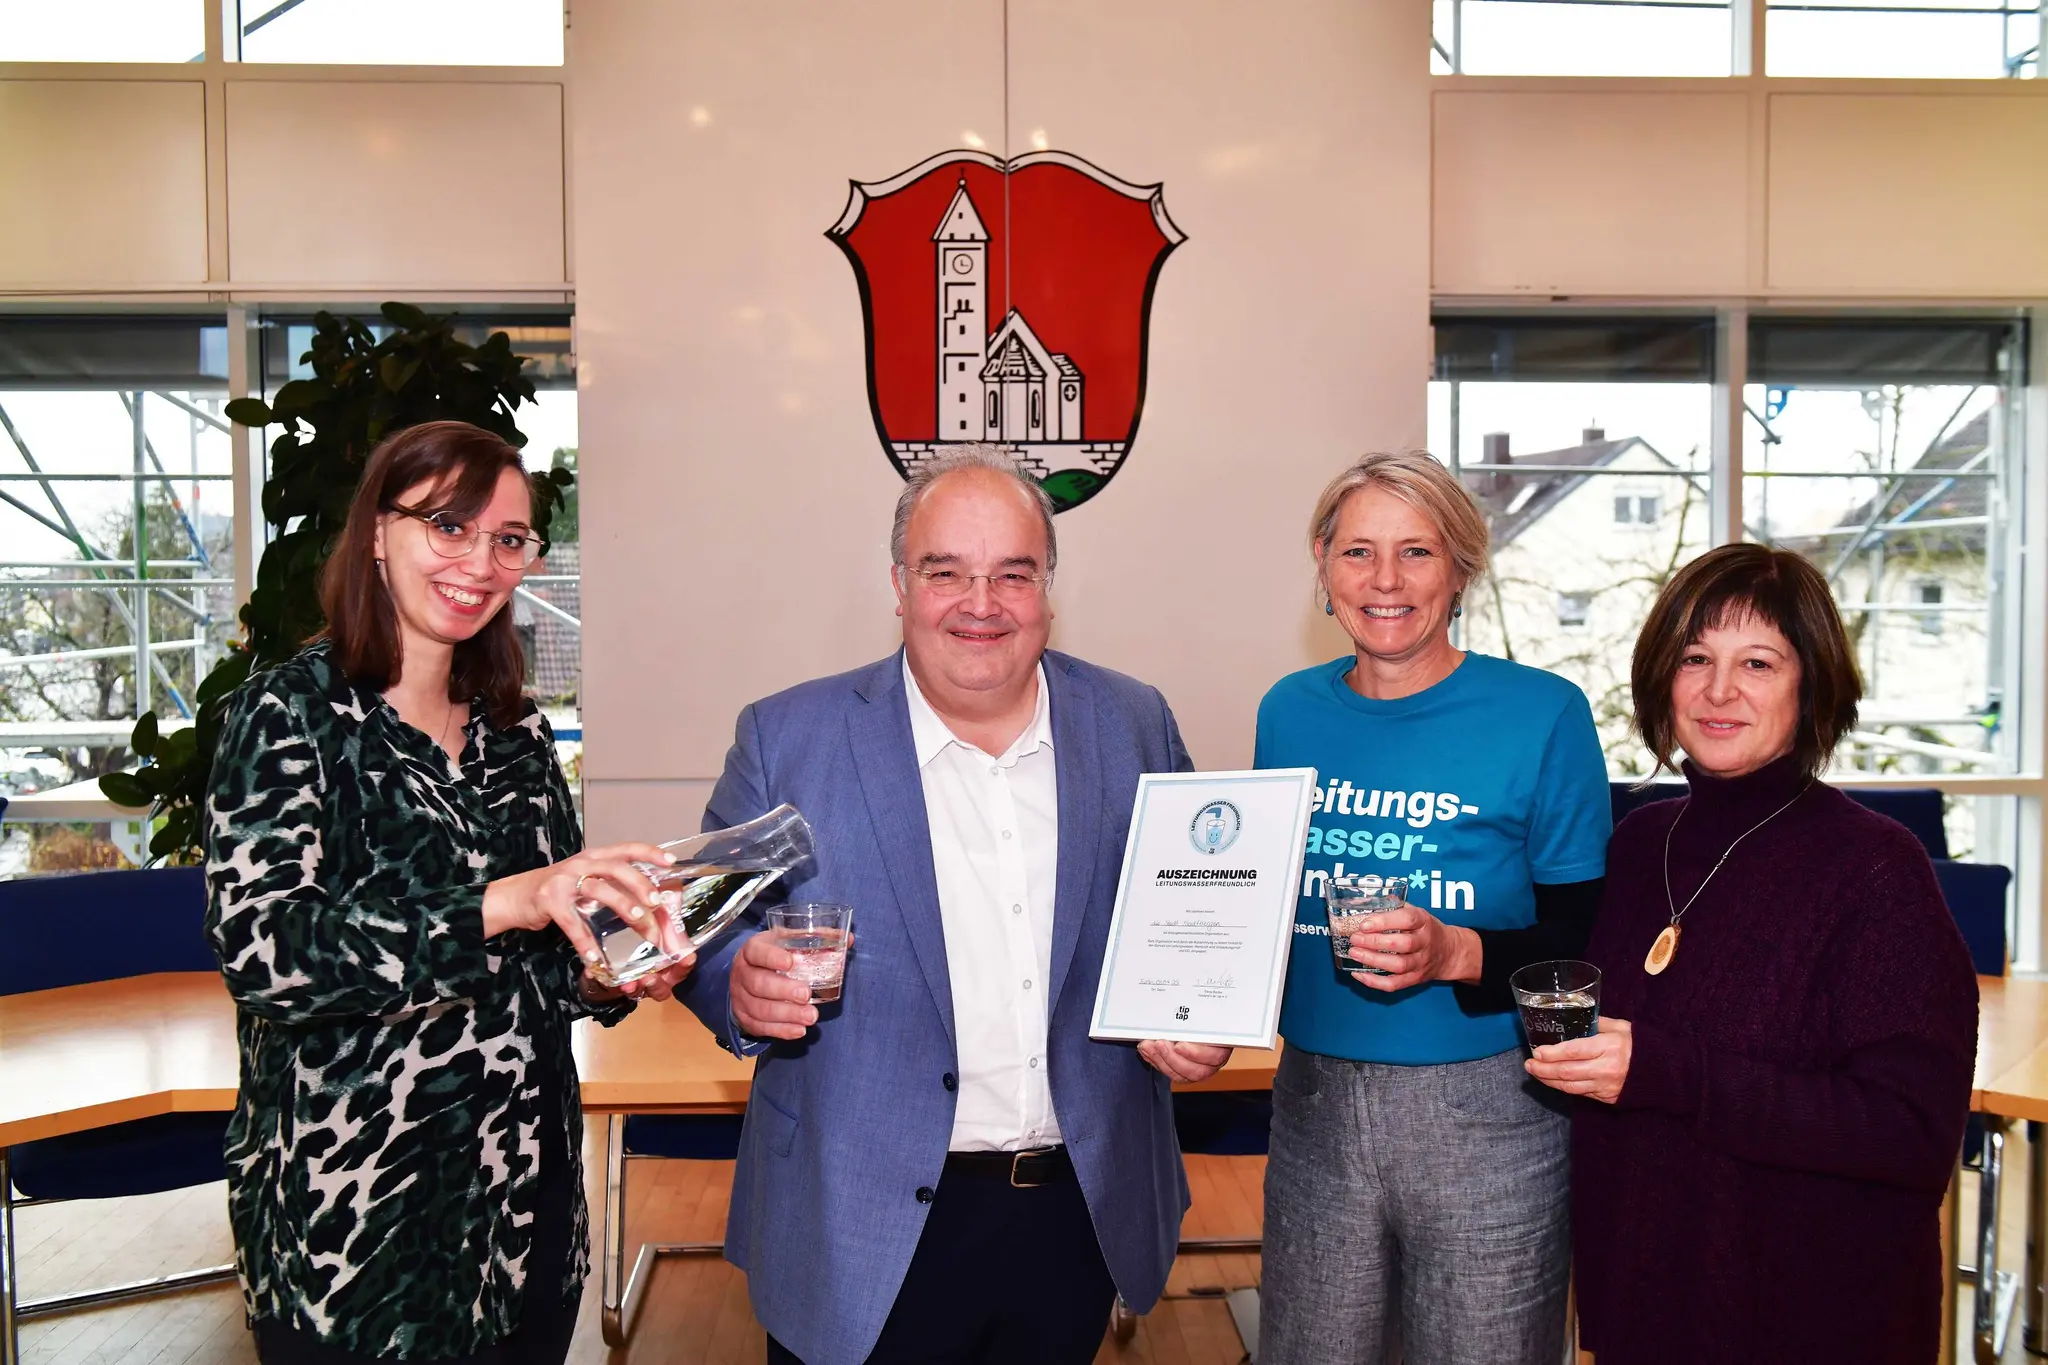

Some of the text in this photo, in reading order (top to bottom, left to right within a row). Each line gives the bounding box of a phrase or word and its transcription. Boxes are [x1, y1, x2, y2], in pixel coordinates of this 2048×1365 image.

[1311, 778, 1479, 828] eitungs-
[1190, 800, 1241, 832] LEITUNGSWASSERFREUNDLICH
[1304, 826, 1438, 861] asser-
[1156, 869, 1257, 880] AUSZEICHNUNG
[1155, 880, 1256, 888] LEITUNGSWASSERFREUNDLICH
[1303, 863, 1475, 910] nkerin
[1294, 922, 1332, 937] sserw
[1179, 1005, 1190, 1014] tip
[1175, 1012, 1189, 1021] tap
[1536, 1022, 1565, 1034] swa
